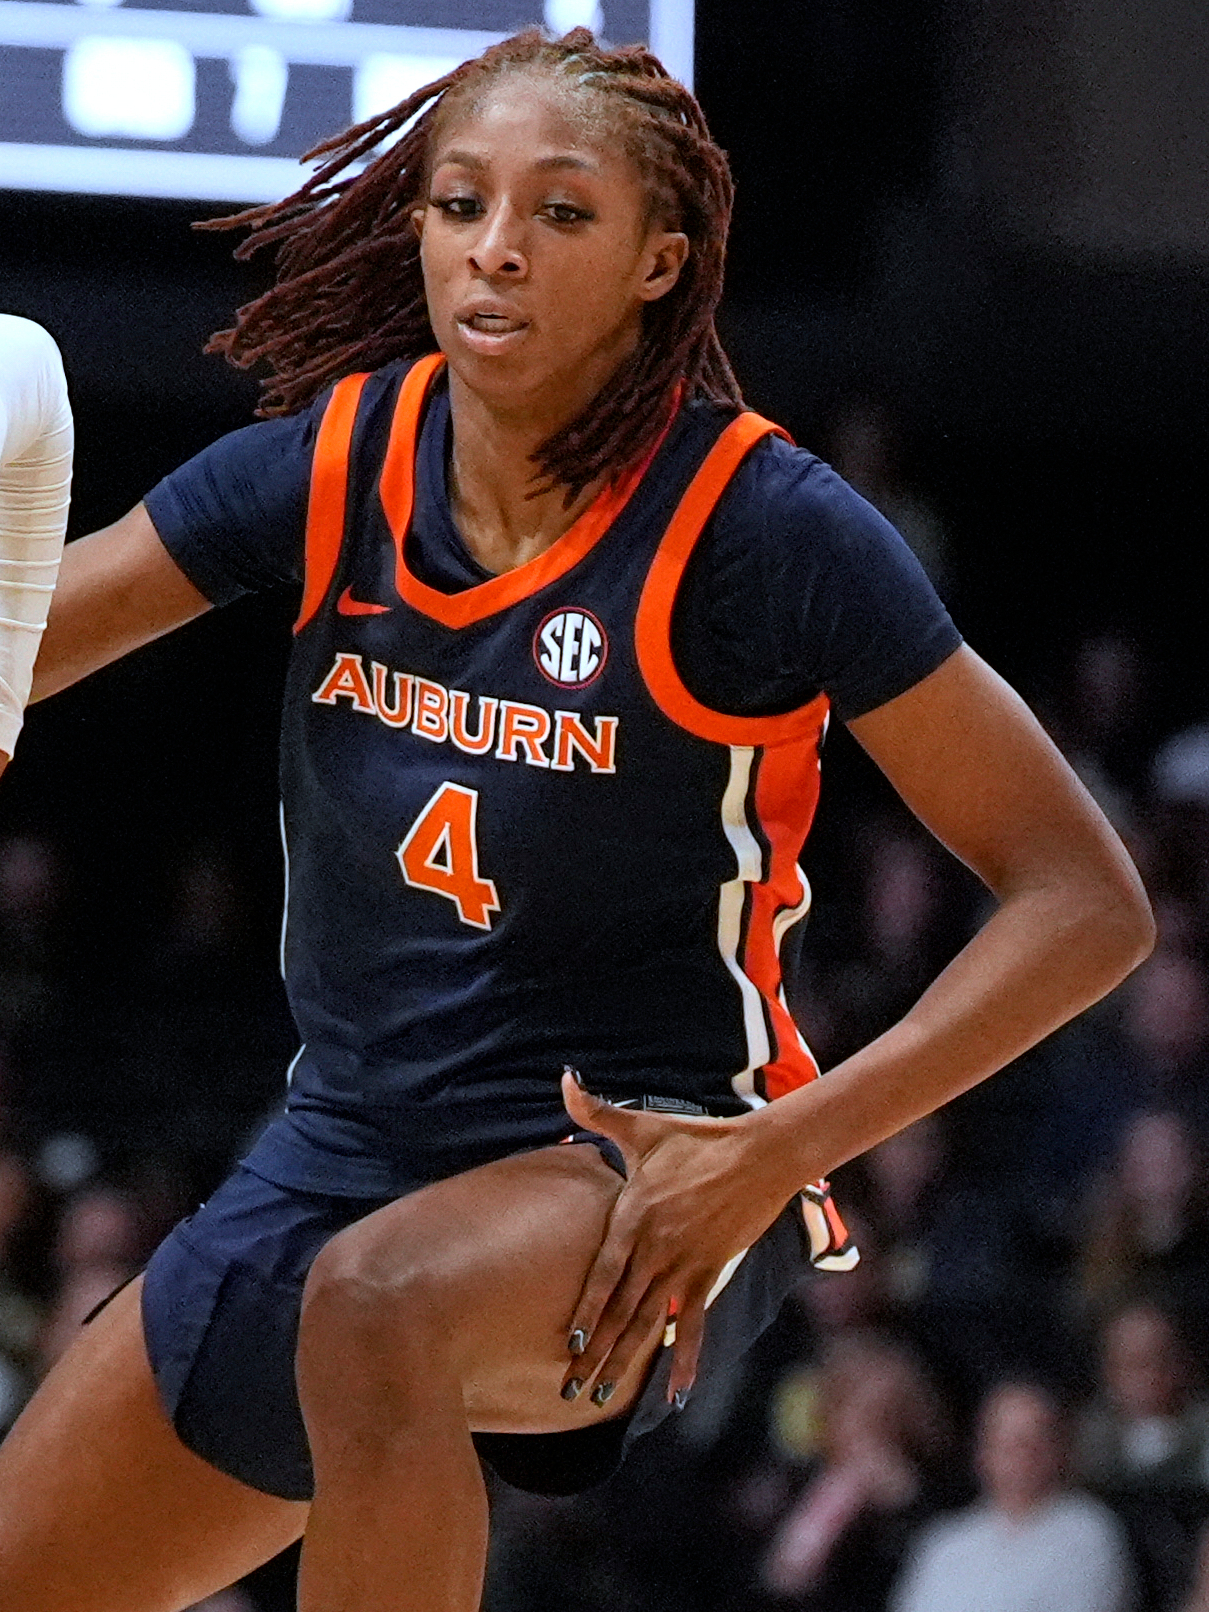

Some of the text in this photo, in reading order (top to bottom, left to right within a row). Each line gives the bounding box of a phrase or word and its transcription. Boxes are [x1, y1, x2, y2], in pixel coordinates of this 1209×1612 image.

[540, 612, 602, 682] SEC
[312, 652, 619, 774] AUBURN
[395, 781, 501, 931] 4
